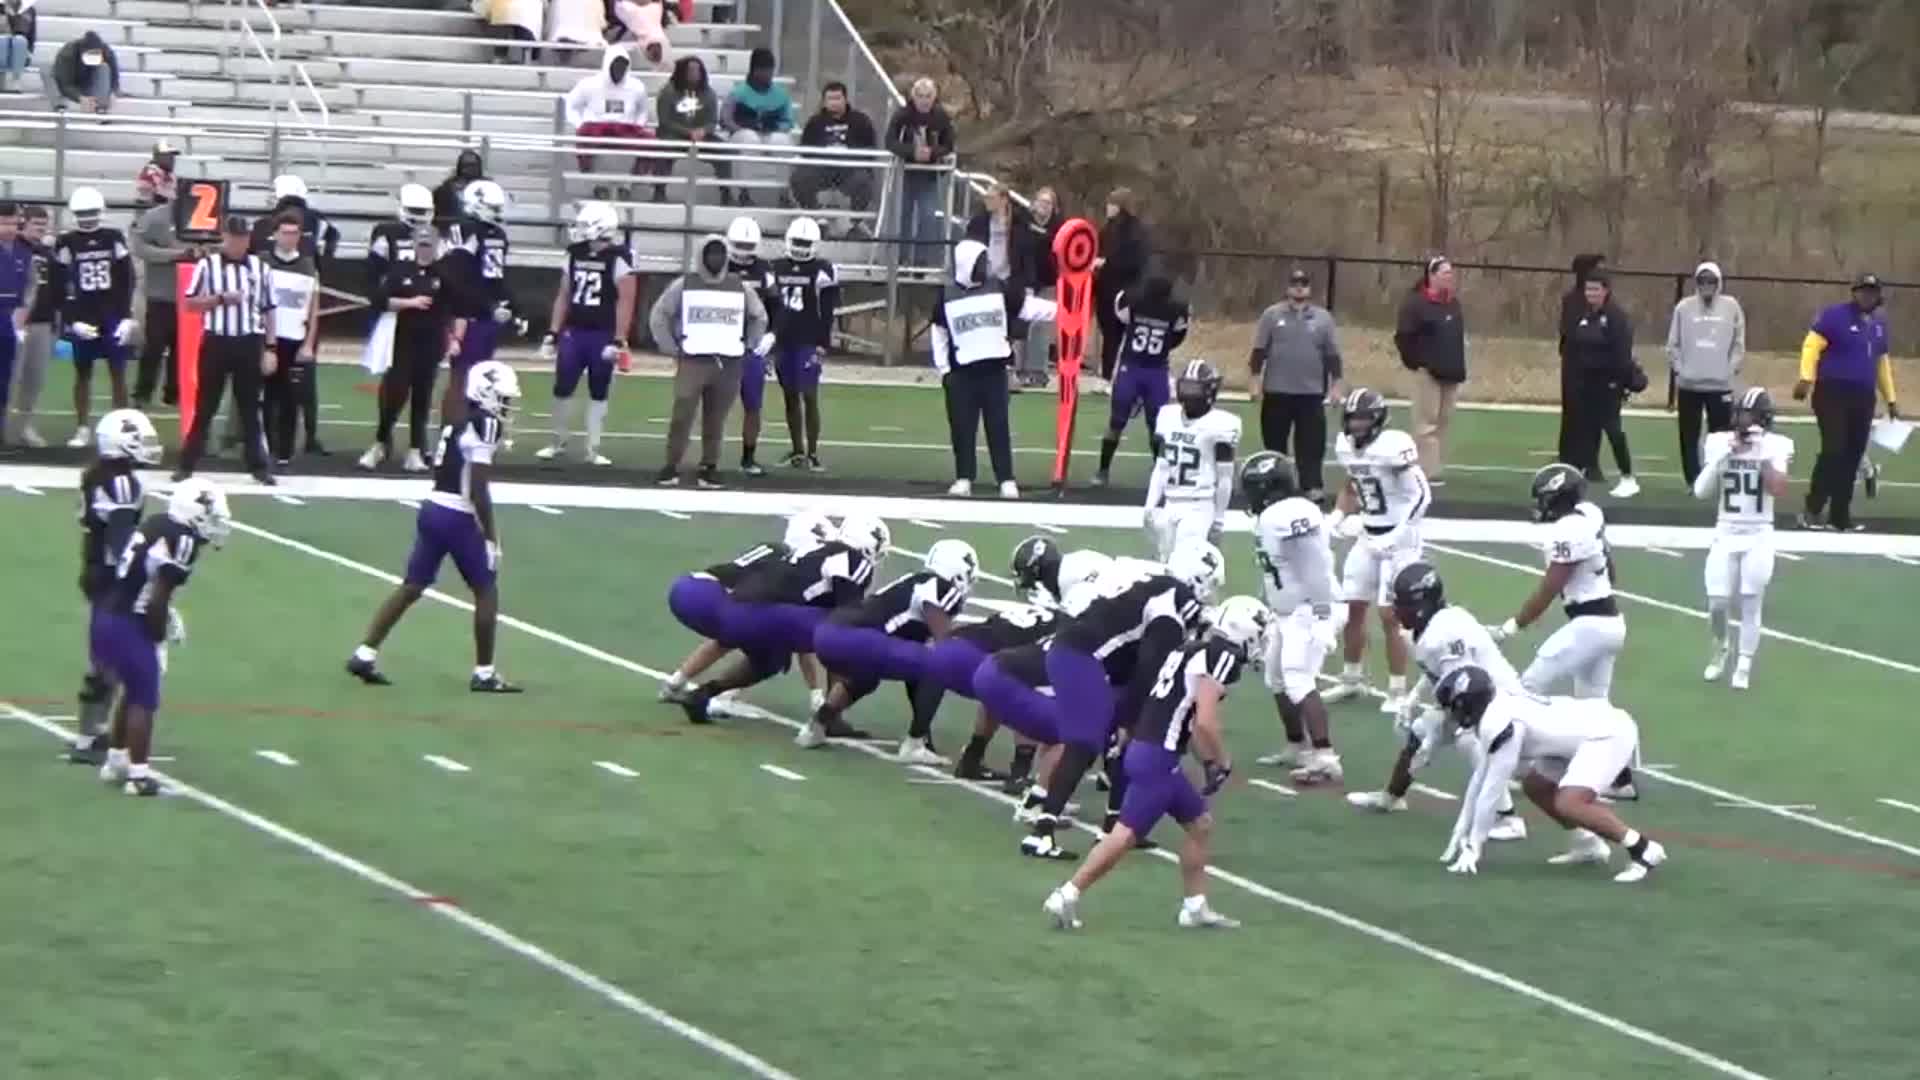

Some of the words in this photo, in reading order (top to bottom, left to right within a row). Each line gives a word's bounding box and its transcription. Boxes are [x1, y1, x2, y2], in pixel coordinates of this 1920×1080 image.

[190, 184, 218, 230] 2
[573, 271, 601, 305] 72
[1131, 325, 1164, 354] 35
[1723, 472, 1763, 513] 24
